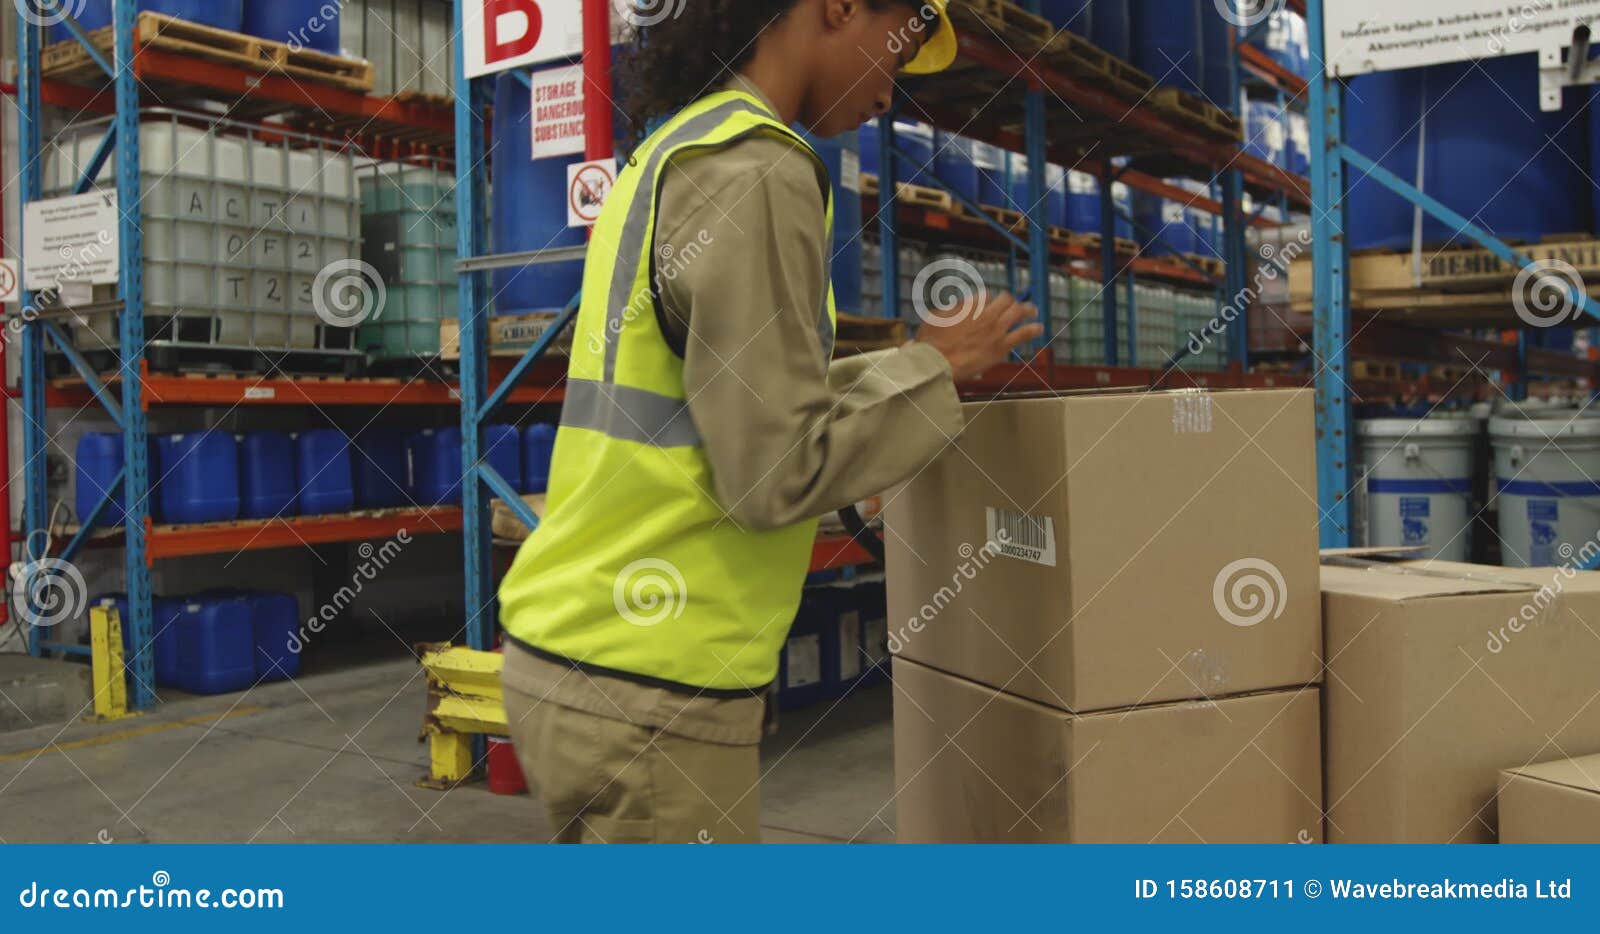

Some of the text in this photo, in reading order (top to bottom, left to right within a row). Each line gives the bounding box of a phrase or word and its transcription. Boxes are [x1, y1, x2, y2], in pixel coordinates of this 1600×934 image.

[535, 81, 576, 102] STORAGE
[537, 100, 583, 122] DANGEROU
[535, 120, 584, 143] SUBSTANC
[1001, 543, 1041, 561] 1000234747
